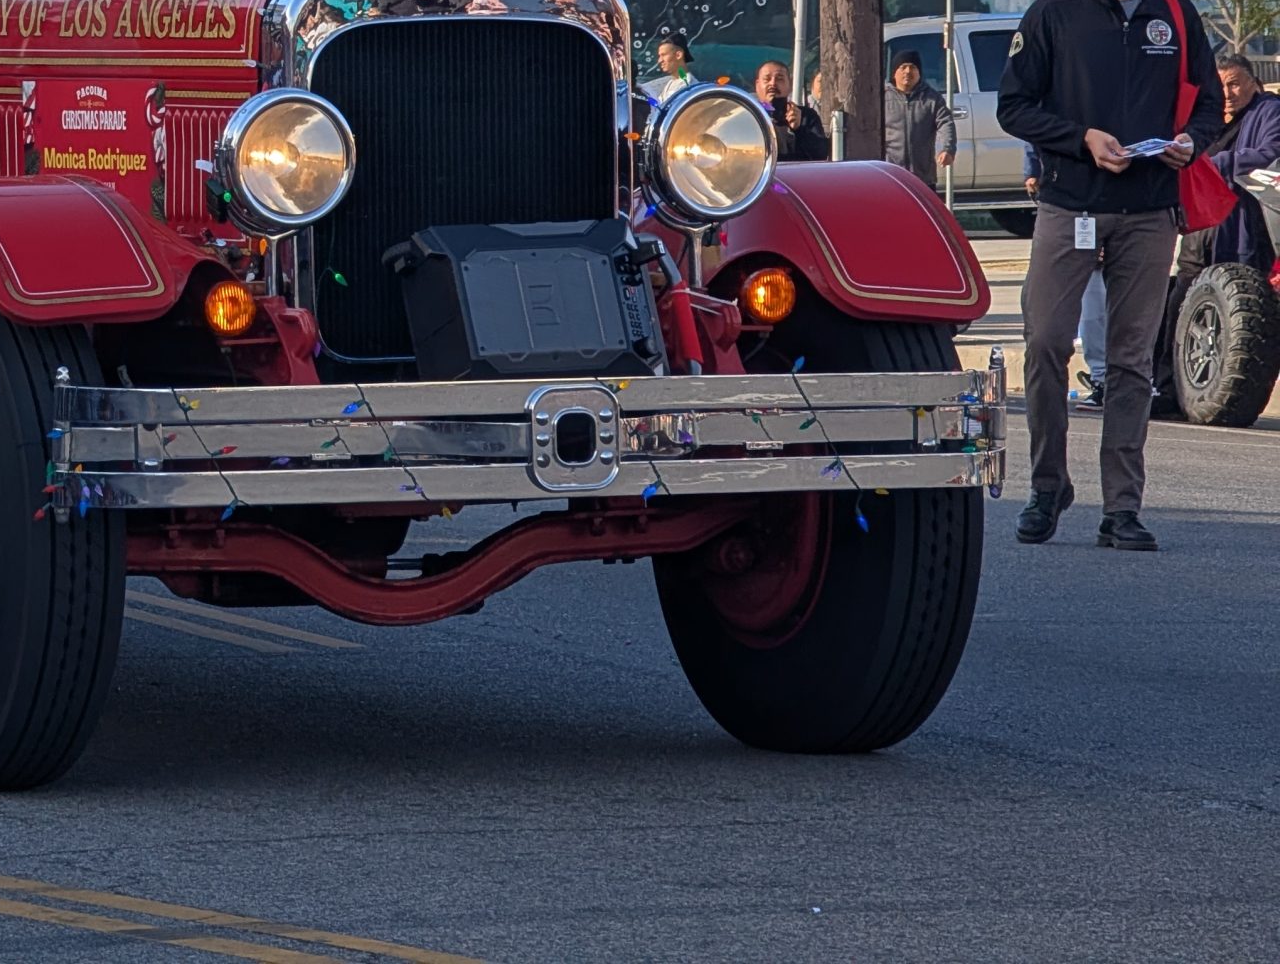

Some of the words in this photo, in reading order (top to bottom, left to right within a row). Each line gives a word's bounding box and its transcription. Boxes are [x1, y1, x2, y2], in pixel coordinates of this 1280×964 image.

[76, 85, 108, 101] PACOIMA
[61, 109, 99, 130] CHRISTMAS
[100, 110, 127, 130] PARADE
[43, 147, 87, 169] Monica
[88, 147, 147, 176] Rodriguez
